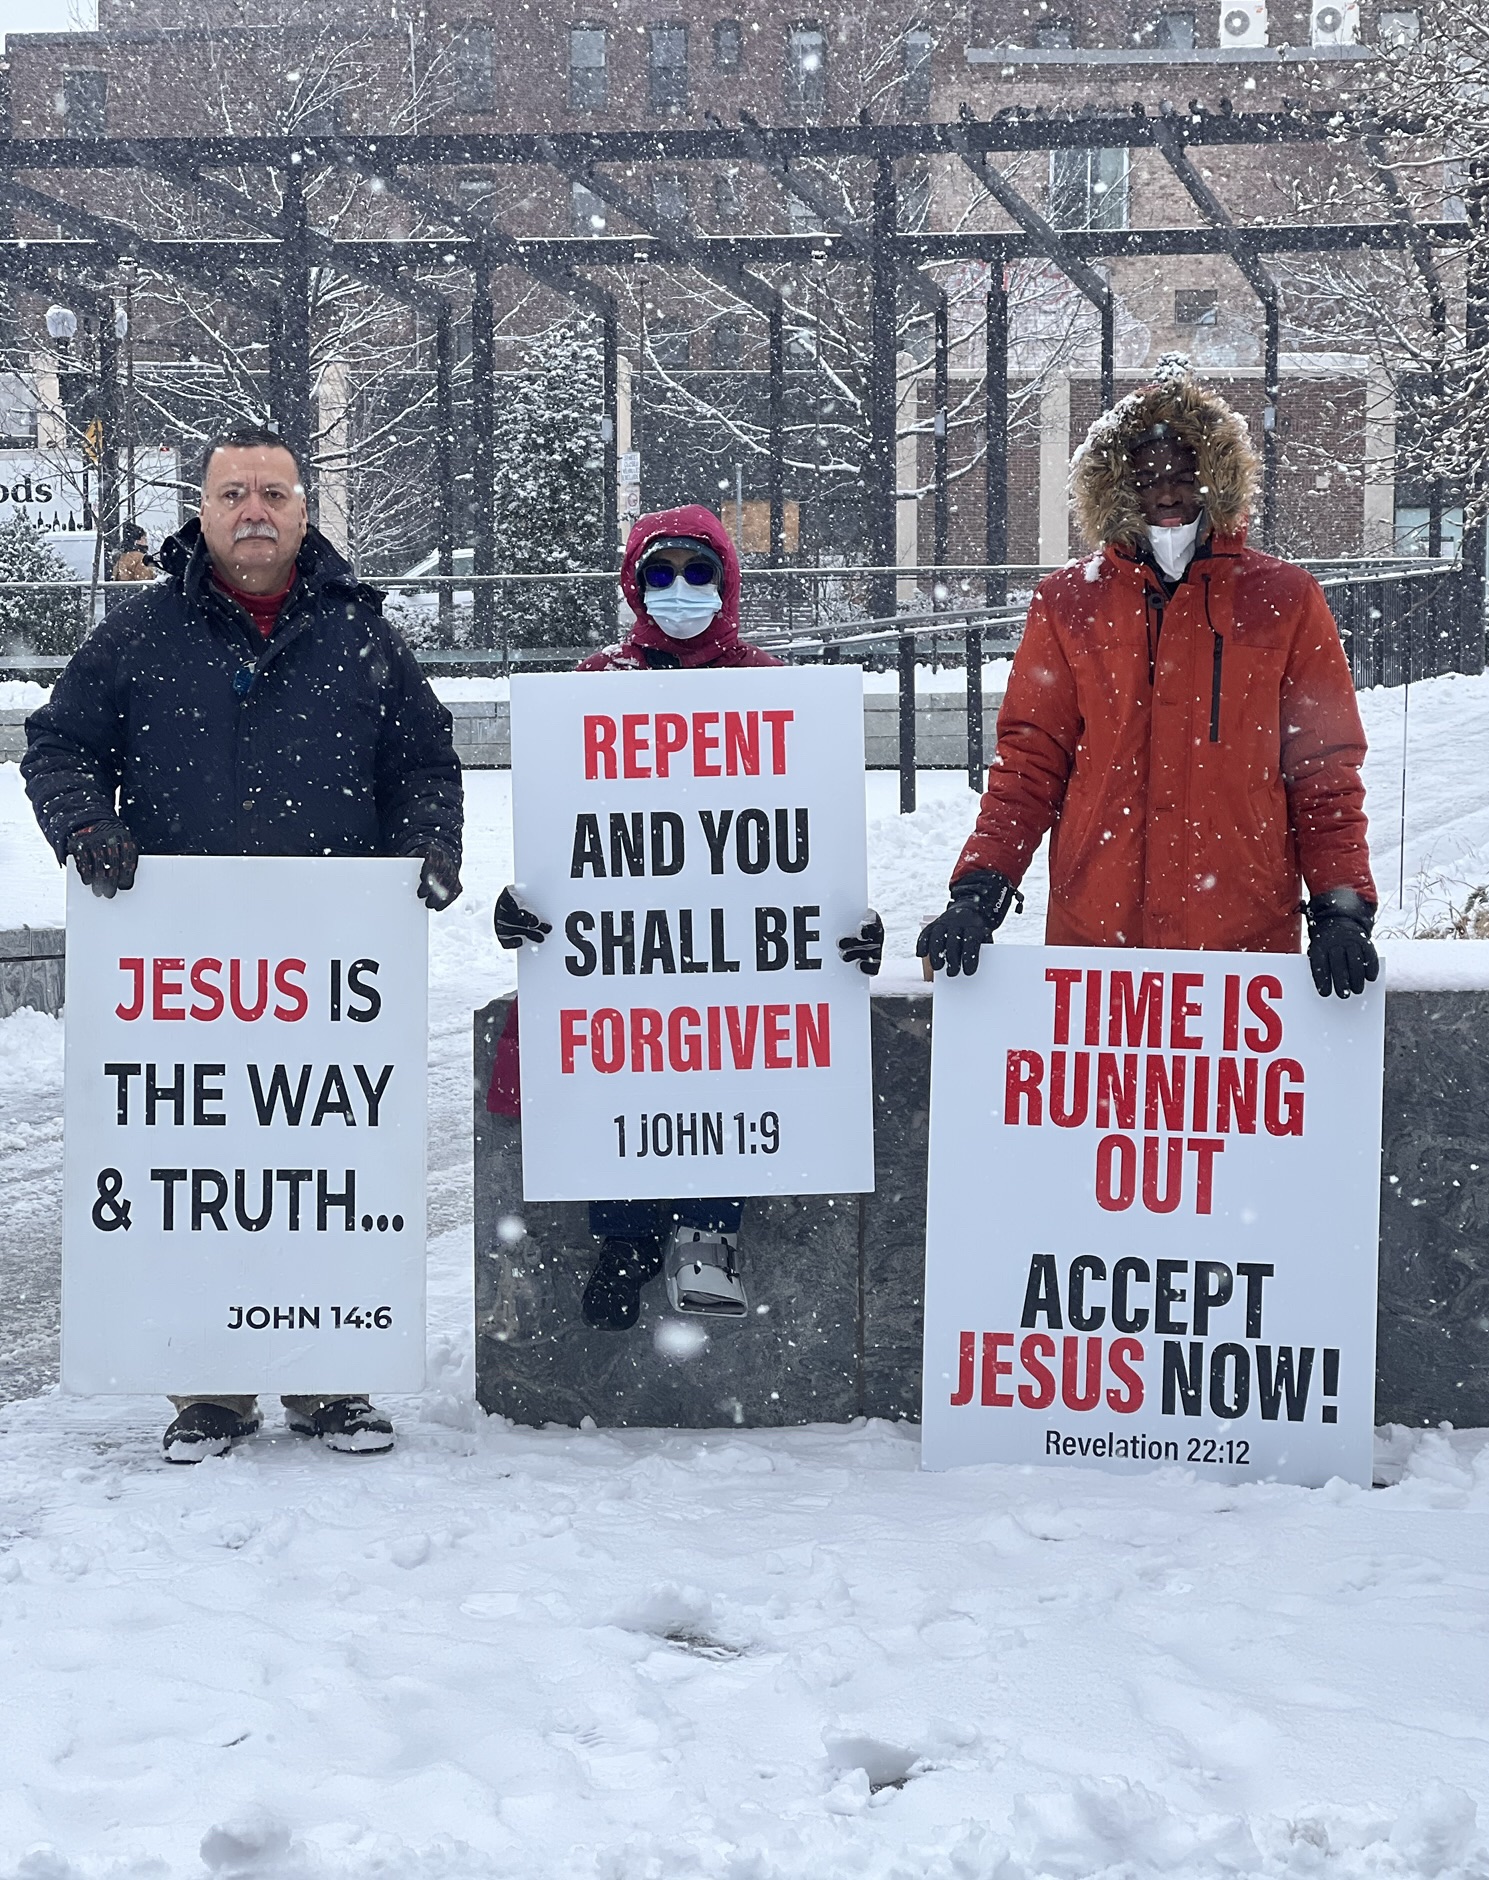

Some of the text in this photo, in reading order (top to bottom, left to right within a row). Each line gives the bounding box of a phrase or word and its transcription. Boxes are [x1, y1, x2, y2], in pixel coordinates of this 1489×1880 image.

[583, 710, 794, 779] REPENT
[569, 808, 810, 878] AND YOU
[564, 906, 823, 976] SHALL BE
[114, 958, 382, 1022] JESUS IS
[1044, 968, 1283, 1053] TIME IS
[559, 1003, 831, 1073] FORGIVEN
[103, 1063, 395, 1126] THE WAY
[1004, 1049, 1305, 1136] RUNNING
[613, 1111, 780, 1157] 1 JOHN 1:9
[91, 1168, 405, 1232] & TRUTH...
[1095, 1134, 1225, 1214] OUT
[226, 1306, 393, 1329] JOHN 14:6
[1019, 1254, 1275, 1338] ACCEPT
[950, 1331, 1340, 1423] JESUS NOW!
[1045, 1430, 1250, 1464] Revelation 22:12
